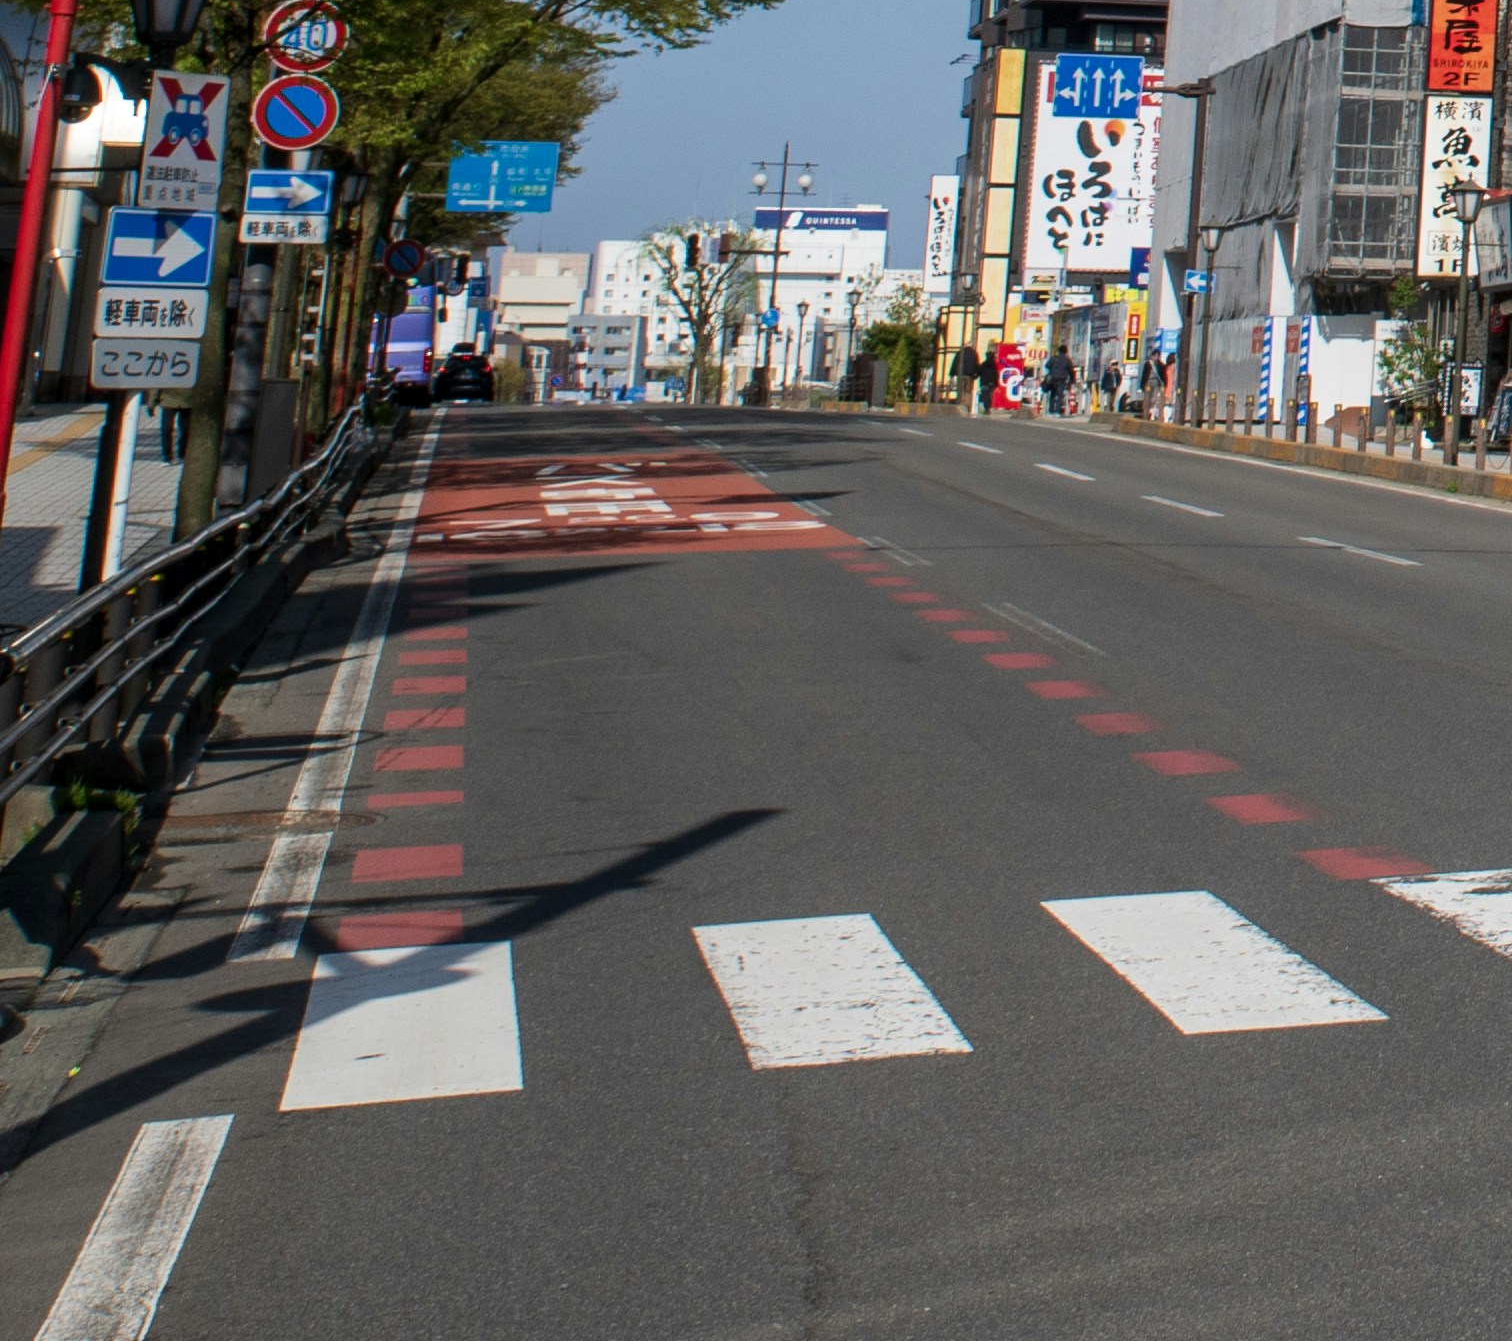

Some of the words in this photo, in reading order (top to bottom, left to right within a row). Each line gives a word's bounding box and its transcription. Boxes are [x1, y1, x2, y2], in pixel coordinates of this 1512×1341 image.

[284, 21, 329, 49] 40
[1432, 58, 1489, 70] SHIROKIYA
[1442, 71, 1481, 87] 2F
[1077, 119, 1126, 248] いろはに
[1043, 168, 1076, 252] ほへと
[247, 220, 318, 241] 軽車両を除く
[104, 298, 196, 328] 軽車両を除く
[101, 349, 191, 378] ここから
